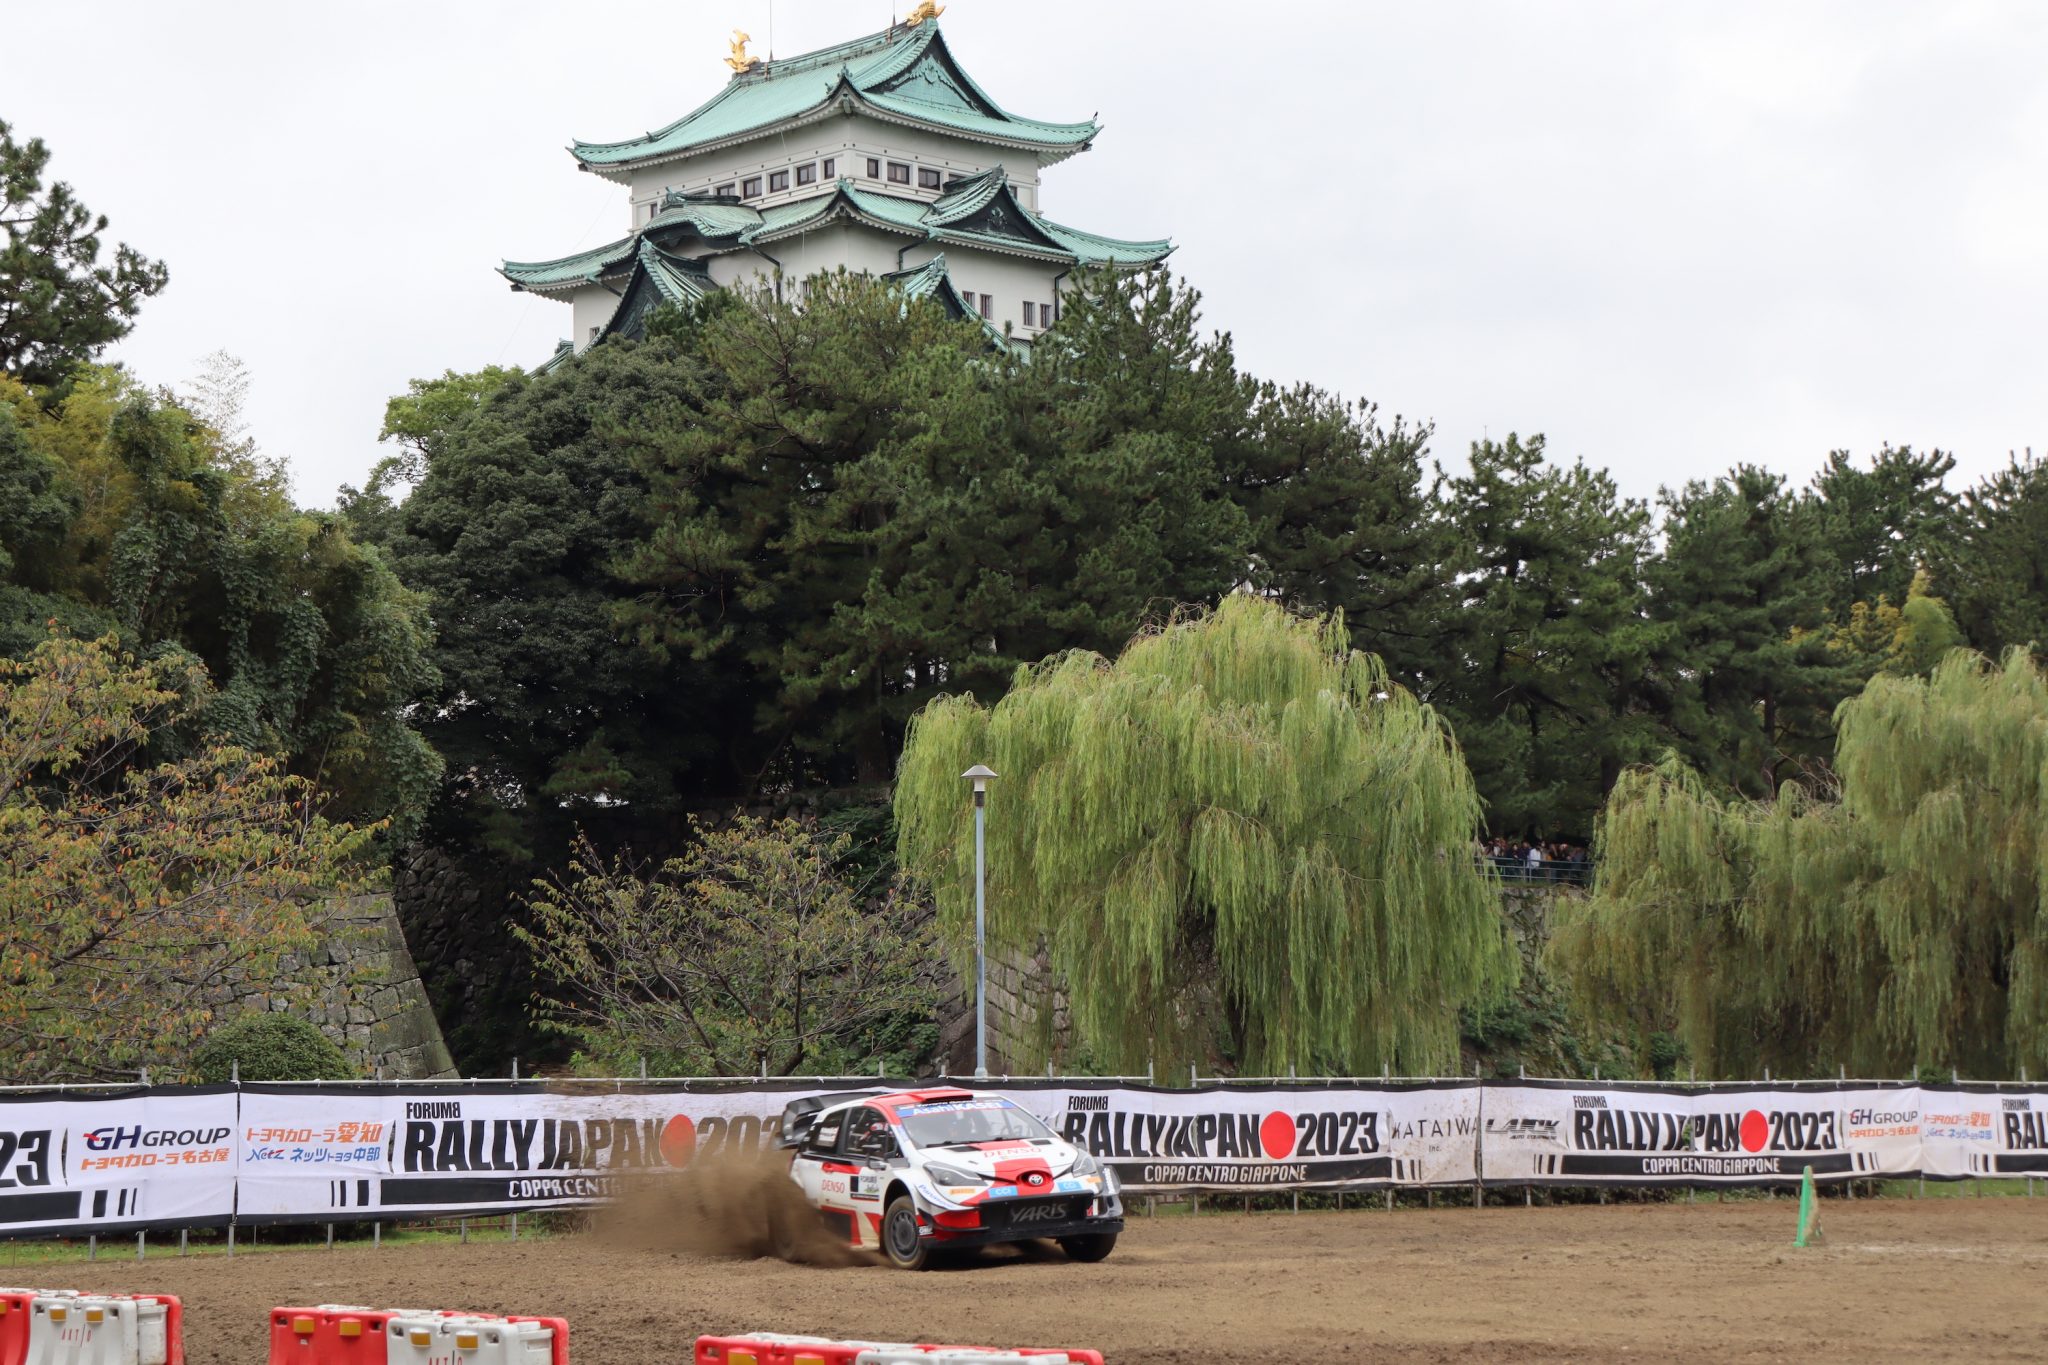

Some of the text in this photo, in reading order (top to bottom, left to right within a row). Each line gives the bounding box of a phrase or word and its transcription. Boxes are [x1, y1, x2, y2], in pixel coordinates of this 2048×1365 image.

[406, 1102, 461, 1119] FORUM8
[1068, 1096, 1108, 1111] FORUM8
[1573, 1095, 1608, 1109] FORUM8
[1873, 1111, 1919, 1125] GROUP
[83, 1125, 231, 1151] GH GROUP
[247, 1121, 383, 1143] トヨタカローラ愛知
[1296, 1112, 1379, 1157] 2023
[1768, 1111, 1836, 1151] 2023
[81, 1148, 230, 1170] トヨタカローラ名古屋
[246, 1147, 380, 1162] Netz ネッツトヨタ中部
[984, 1147, 1042, 1158] DENSO
[1144, 1165, 1307, 1183] COPPA CENTRO GIAPPONE
[1643, 1157, 1780, 1174] COPPA CENTRO GIAPPONE
[509, 1179, 563, 1198] COPPA
[822, 1179, 845, 1194] DENSO
